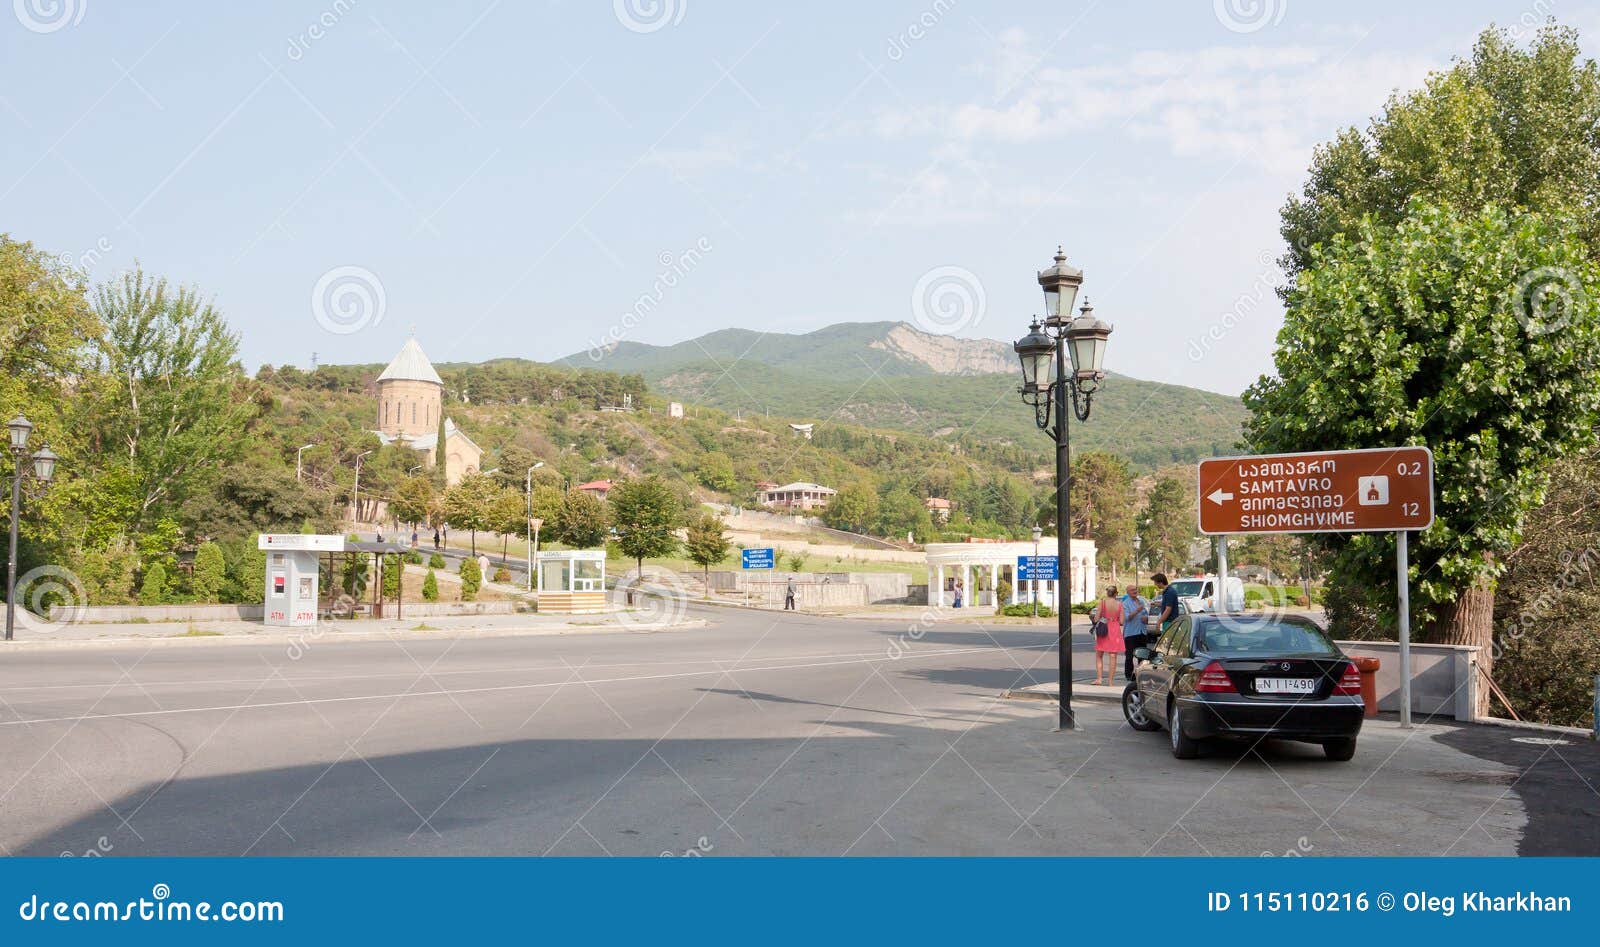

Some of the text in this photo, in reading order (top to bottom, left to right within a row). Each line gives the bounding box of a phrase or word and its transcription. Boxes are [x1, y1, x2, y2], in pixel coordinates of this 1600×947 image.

[1238, 460, 1336, 477] სამთავრო
[1397, 462, 1422, 476] 0.2
[1240, 477, 1332, 494] SAMTAVRO
[1240, 494, 1344, 511] შიომღვიმე
[1402, 503, 1420, 516] 12
[1240, 511, 1355, 528] SHIOMGHVIME
[270, 611, 285, 620] ATM
[296, 611, 314, 620] ATM
